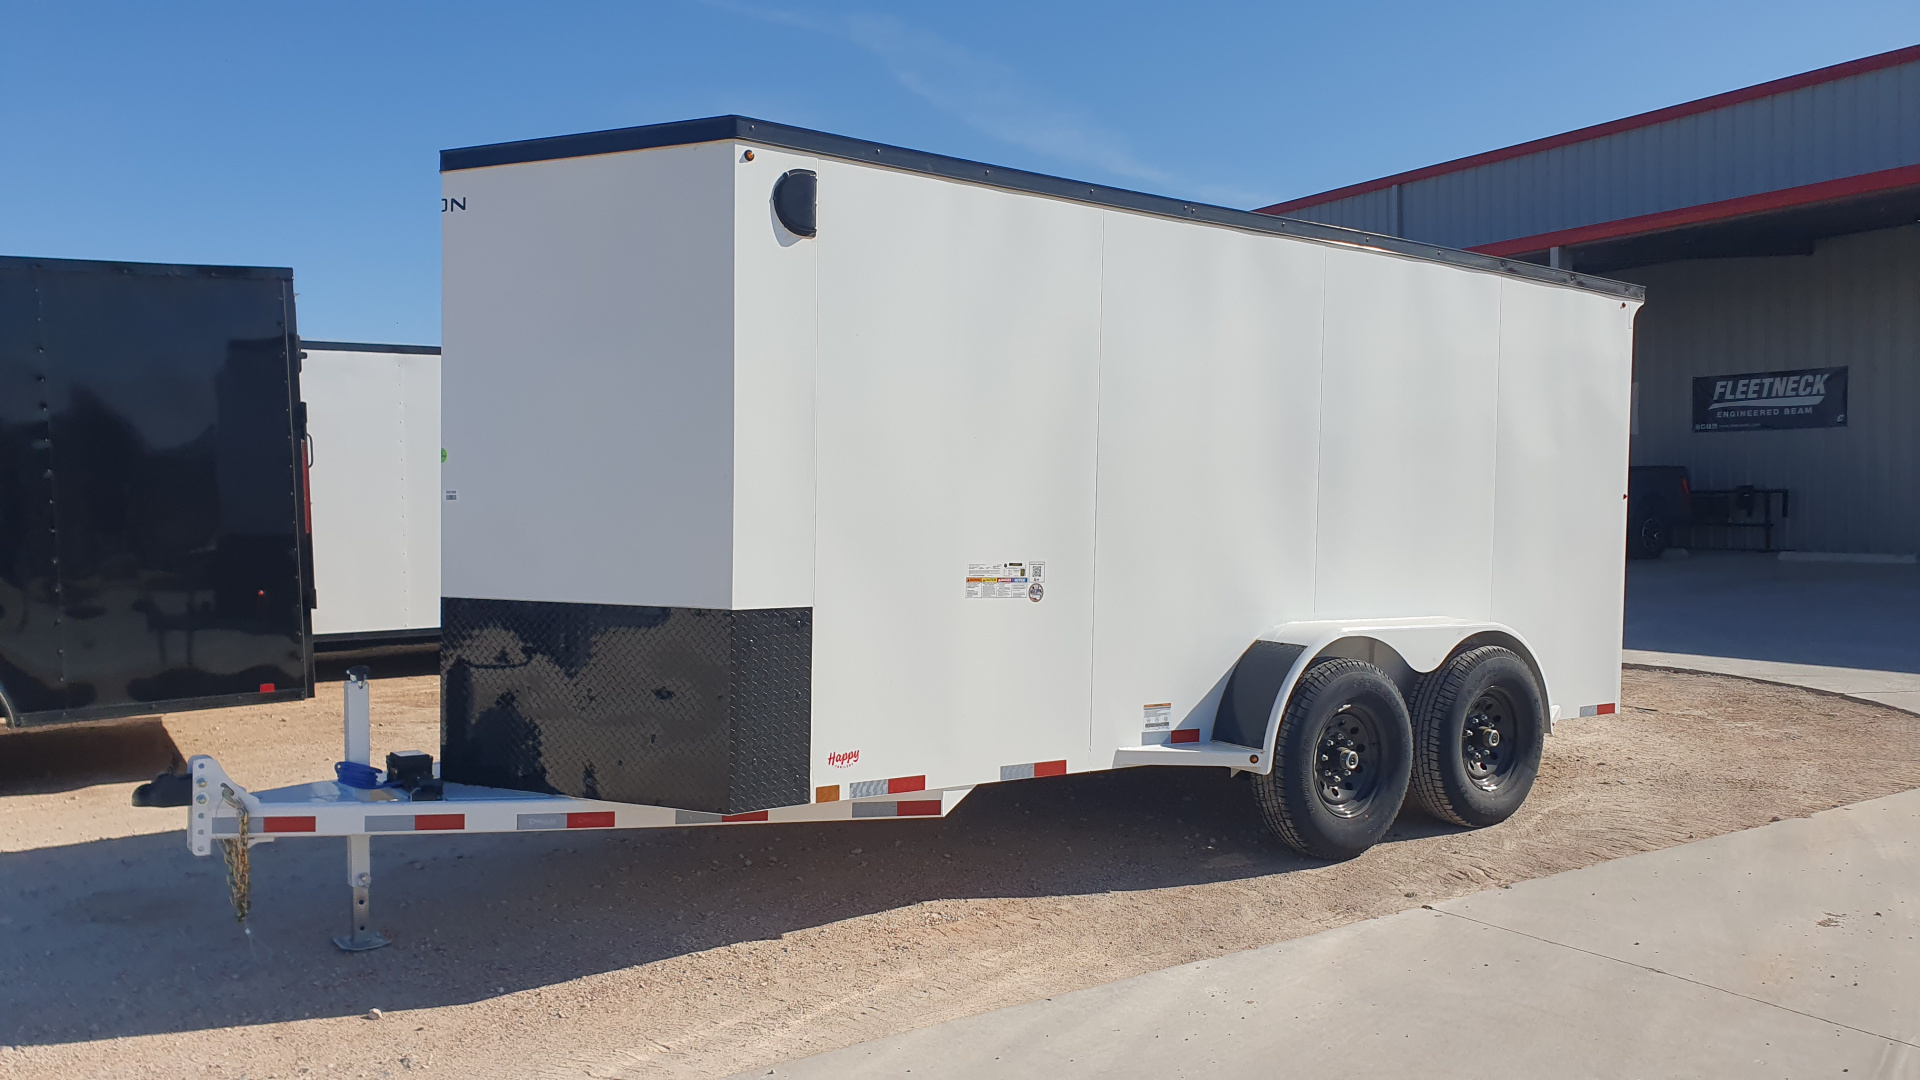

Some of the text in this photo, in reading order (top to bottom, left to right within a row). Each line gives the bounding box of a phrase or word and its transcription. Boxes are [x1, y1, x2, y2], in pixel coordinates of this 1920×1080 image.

[1713, 374, 1830, 400] FLEETNECK
[1717, 407, 1813, 418] ENGINEERED BEAM
[828, 749, 860, 766] Happy
